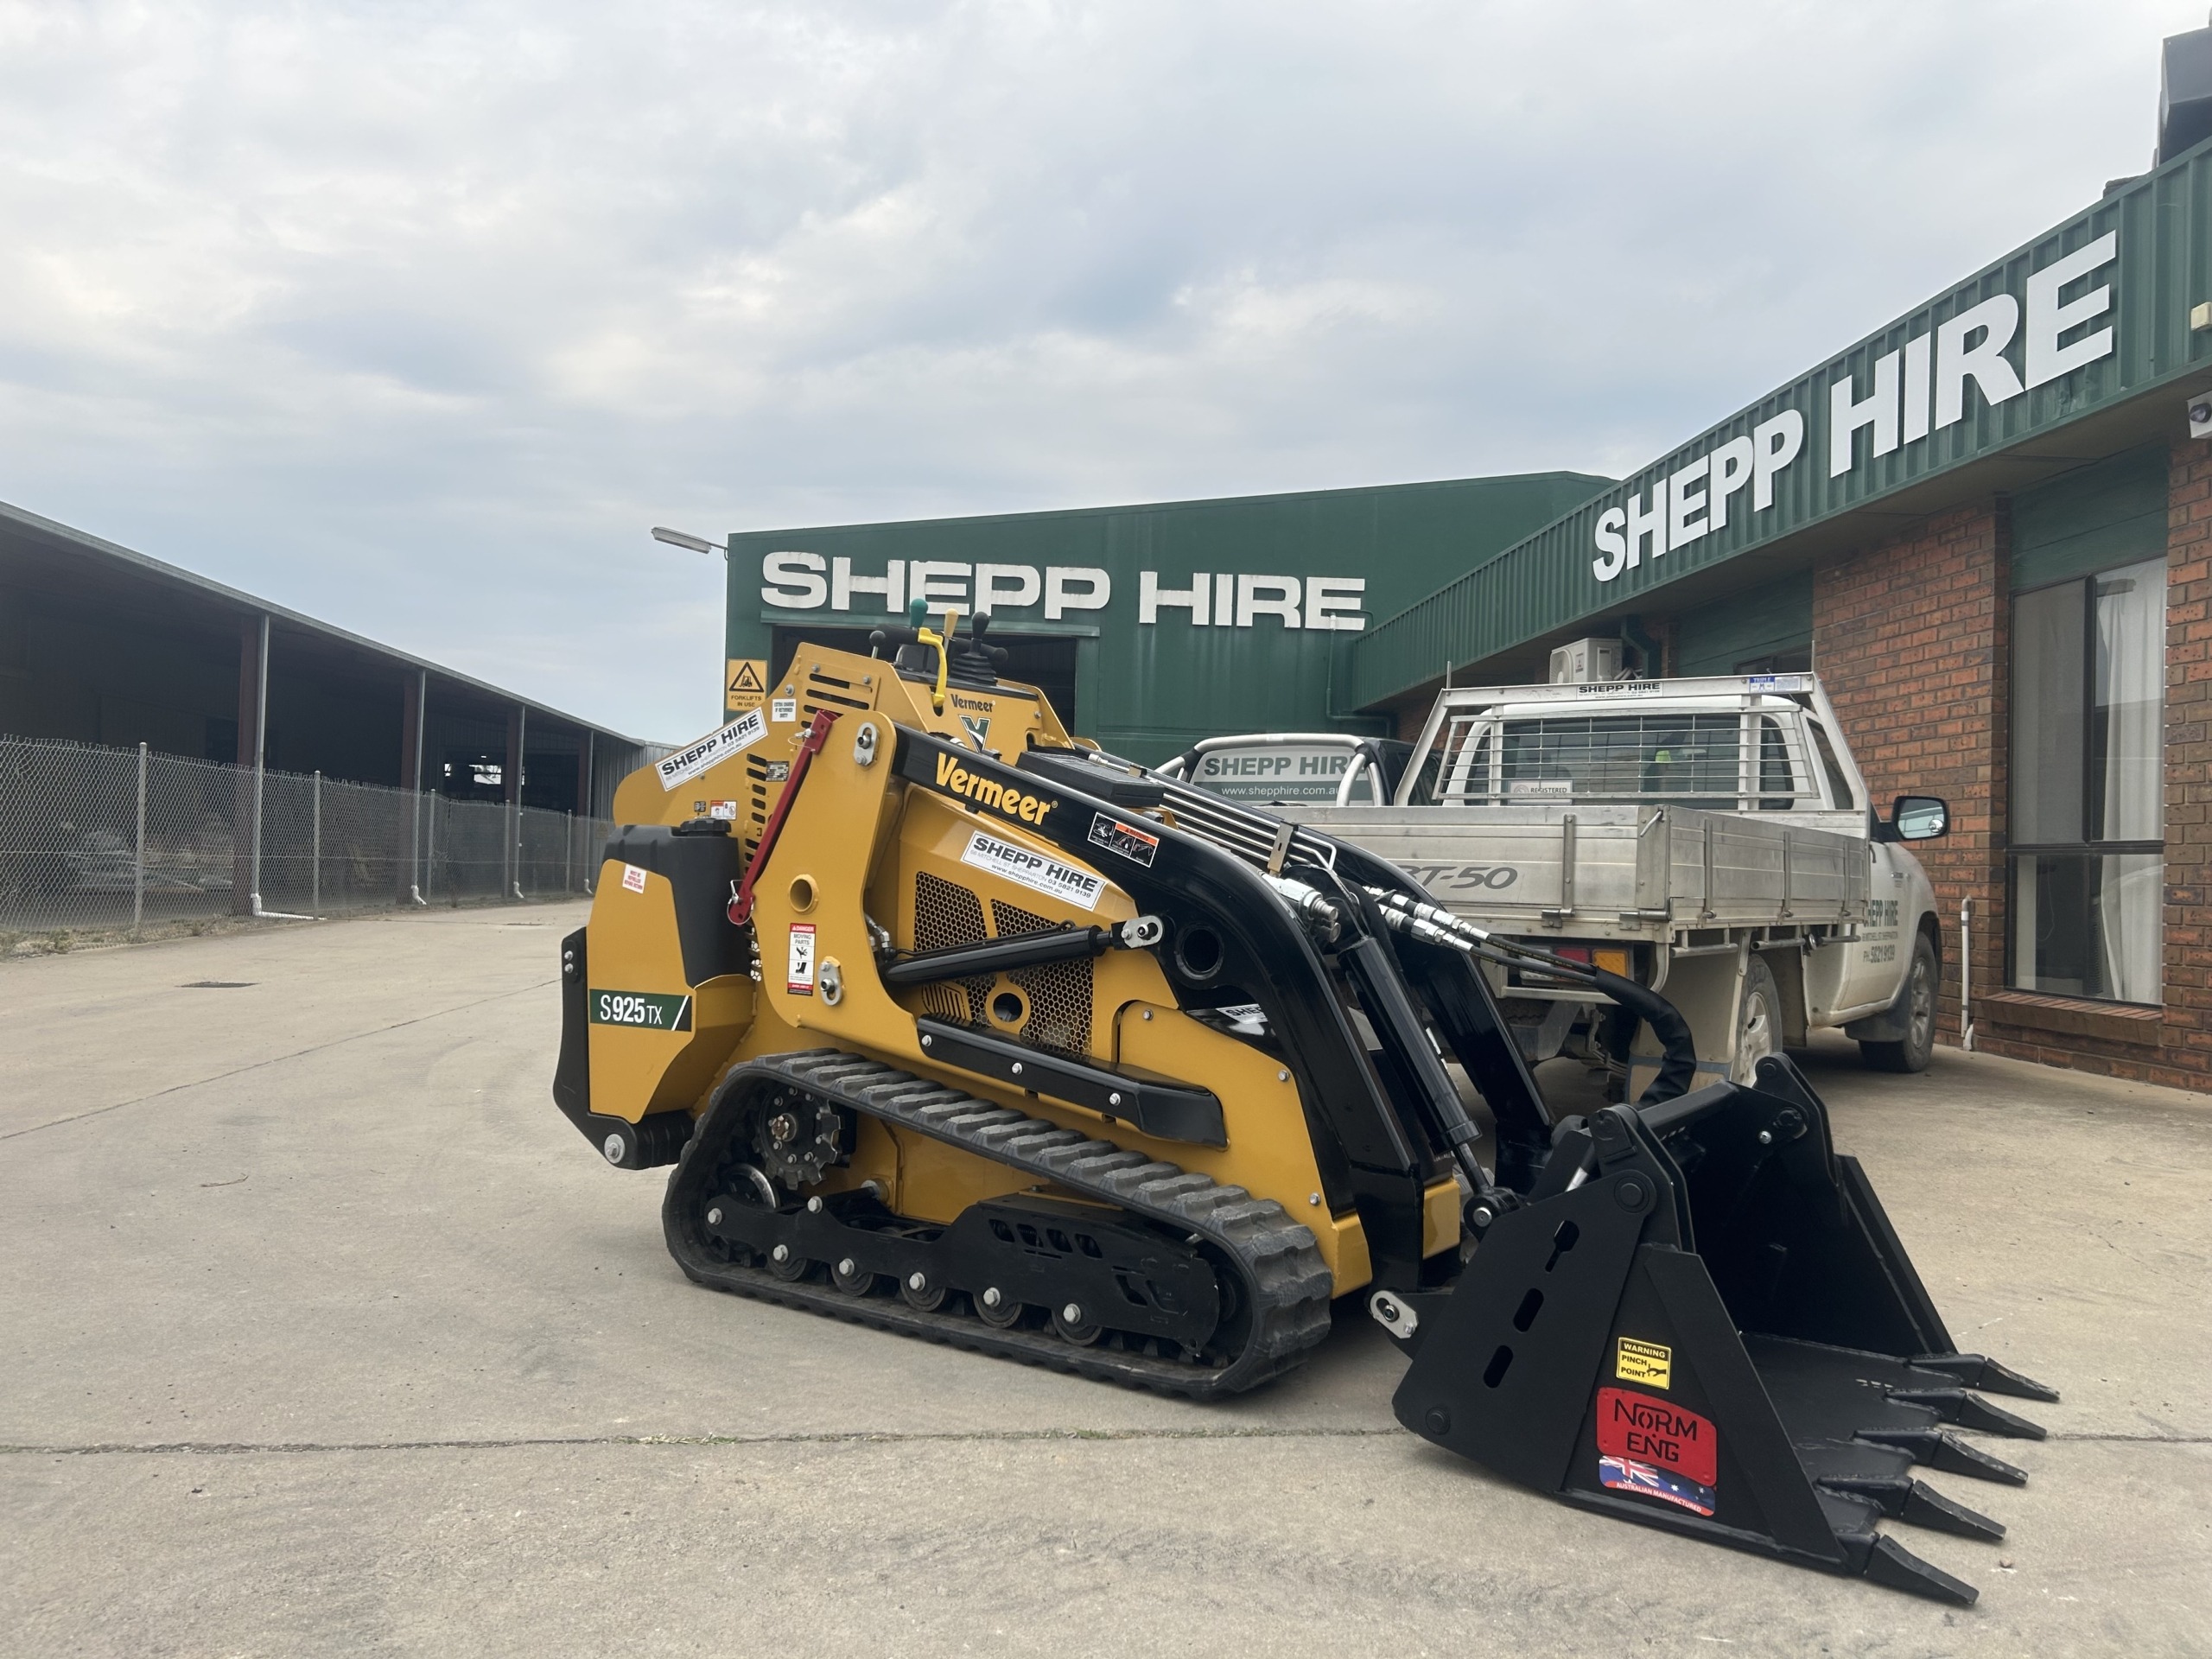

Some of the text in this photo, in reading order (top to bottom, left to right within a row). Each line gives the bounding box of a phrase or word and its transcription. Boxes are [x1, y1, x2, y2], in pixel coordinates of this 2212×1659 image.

[1592, 230, 2116, 582] SHEPP HIRE
[761, 551, 1366, 630] SHEPP HIRE
[950, 694, 994, 712] Vermeer
[1579, 684, 1624, 693] SHEPP
[662, 715, 759, 775] SHEPP HIRE
[1204, 756, 1365, 776] SHEPP HIR
[936, 752, 1051, 826] Vermeer
[973, 837, 1098, 893] SHEPP HIRE
[991, 864, 1063, 894] www.shepphire.com.au
[1058, 882, 1074, 893] 5821
[1075, 888, 1090, 899] 9139
[1885, 899, 1898, 927] HIRE
[1621, 1354, 1647, 1366] PINCH
[1623, 1342, 1666, 1358] WARNING
[1621, 1366, 1646, 1378] POINT
[1614, 1398, 1698, 1441] NORM
[1627, 1432, 1679, 1462] ENG
[1616, 1482, 1702, 1513] AUSTRALIAN MANUFACTURED
